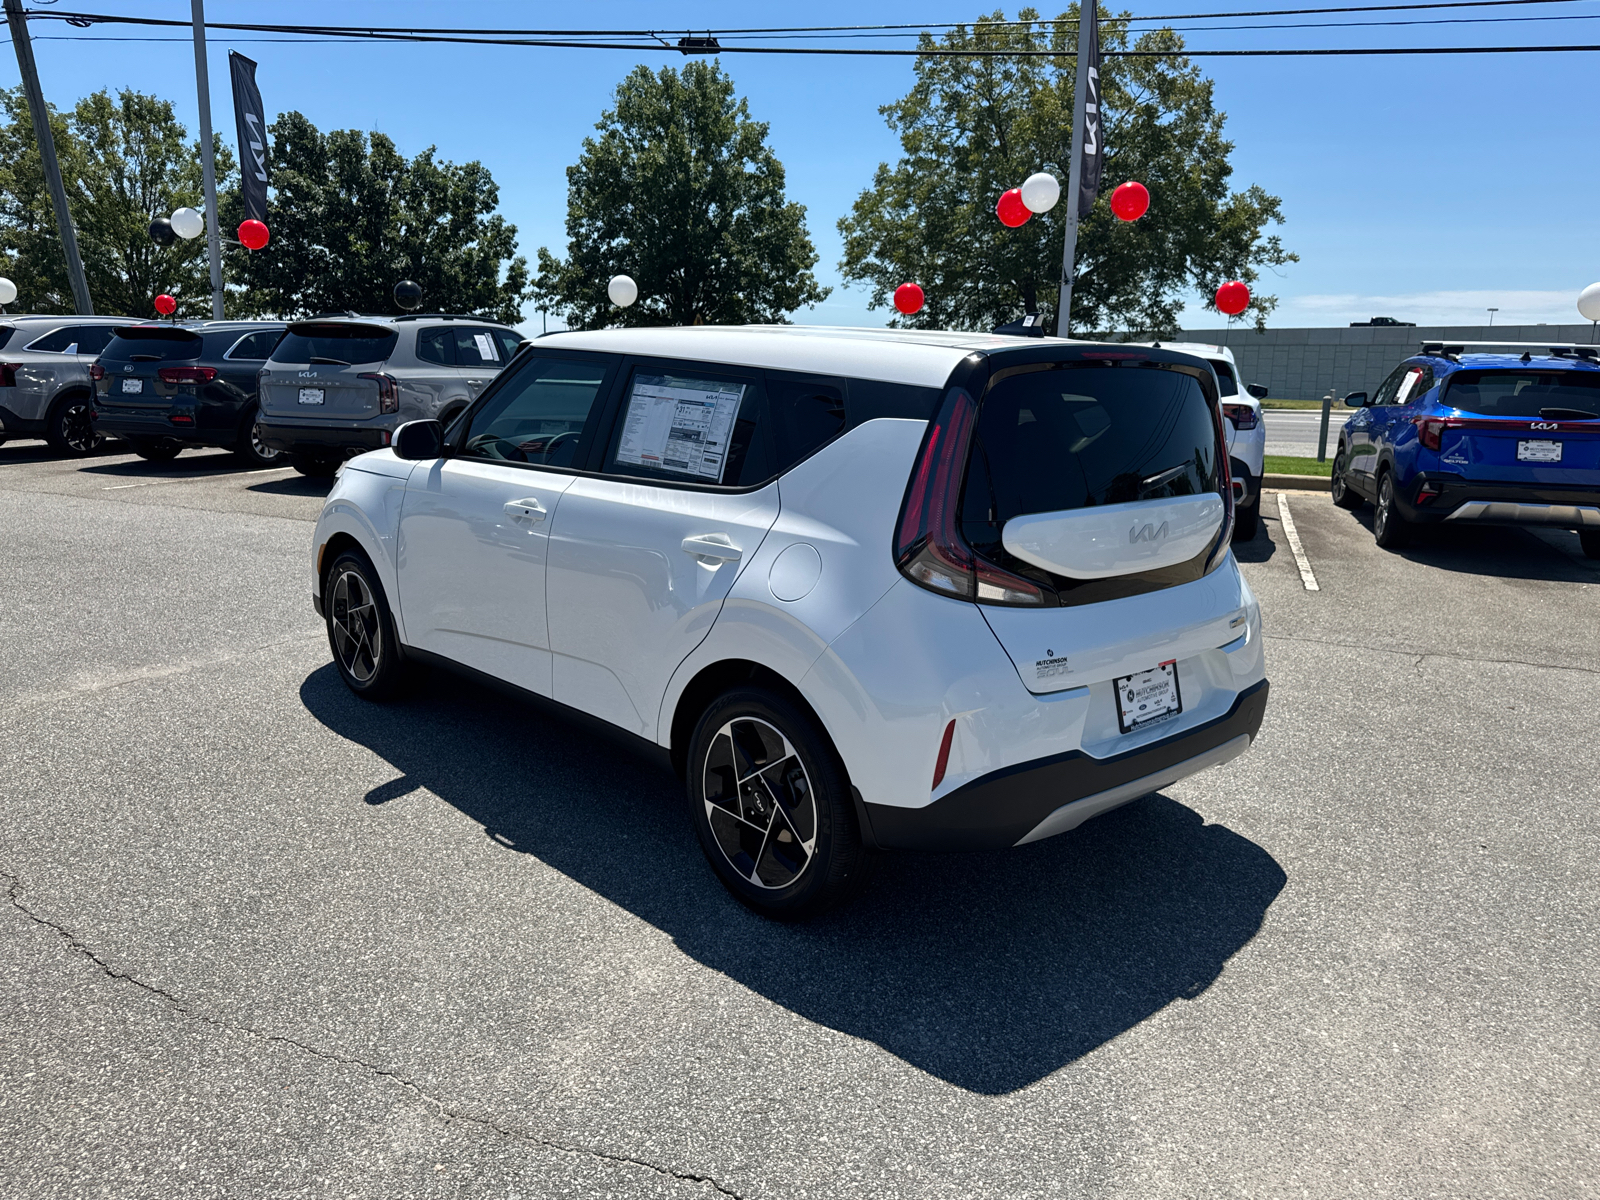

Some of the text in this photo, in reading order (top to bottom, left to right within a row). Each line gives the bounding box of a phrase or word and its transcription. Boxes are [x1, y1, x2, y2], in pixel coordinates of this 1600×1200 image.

[245, 112, 268, 183] KIA
[1530, 422, 1558, 430] KIA
[1129, 520, 1169, 544] KIA
[1035, 657, 1068, 666] HUTCHINSON
[1136, 680, 1170, 698] HUTCHINSON
